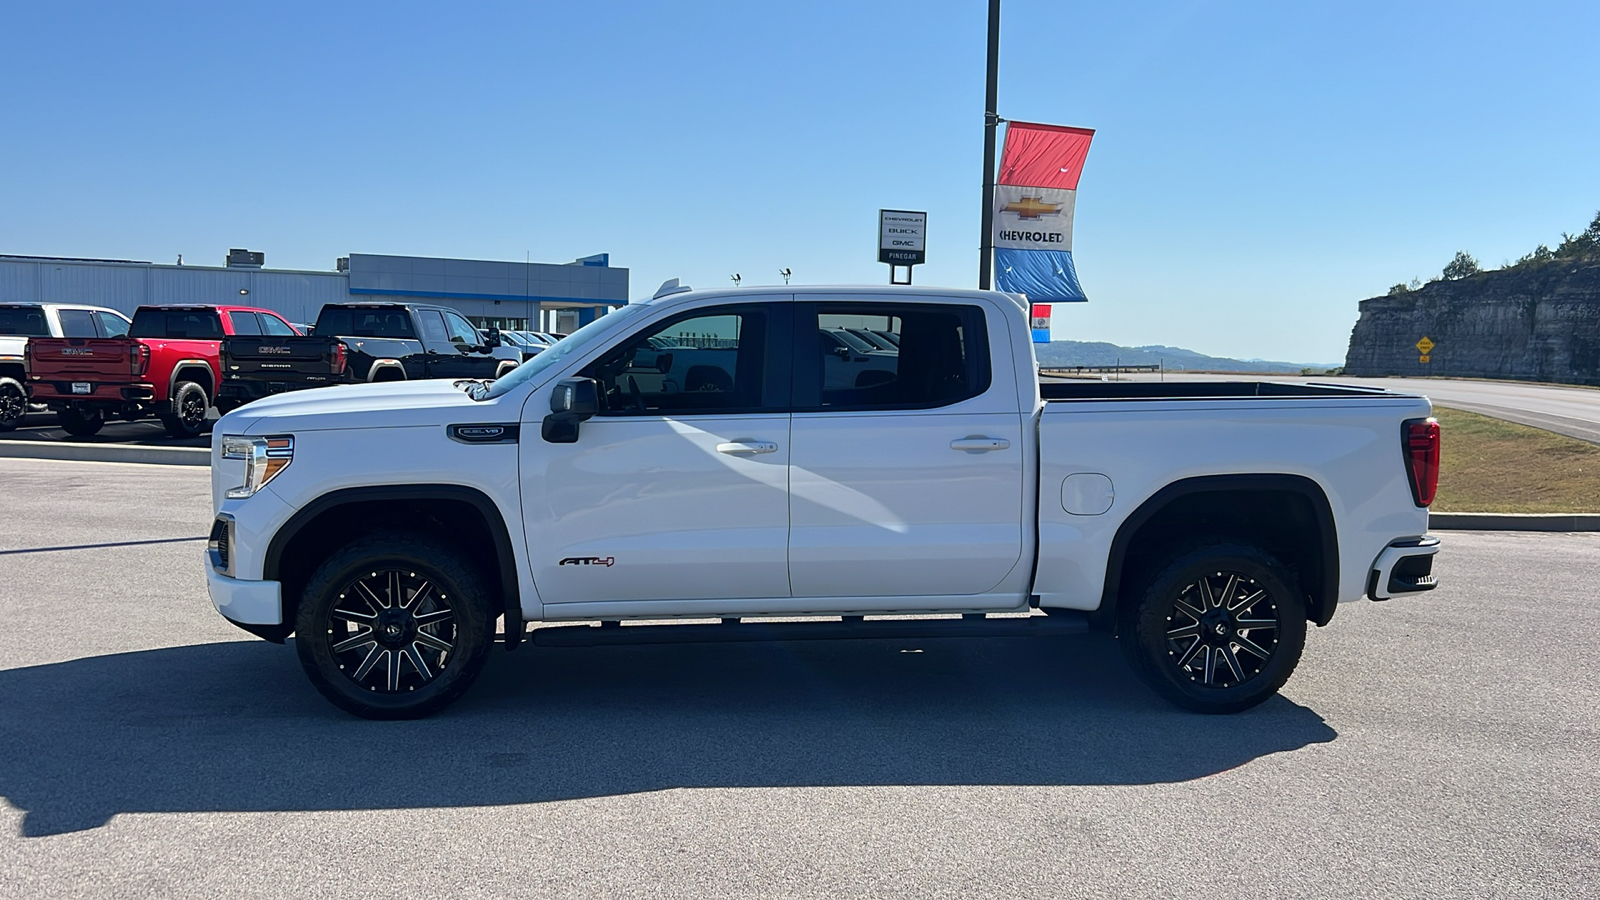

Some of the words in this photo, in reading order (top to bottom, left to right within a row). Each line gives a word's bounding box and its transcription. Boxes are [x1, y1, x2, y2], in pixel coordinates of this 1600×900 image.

[888, 252, 917, 260] PINEGAR
[258, 346, 291, 354] GMC
[559, 557, 614, 567] AT4
